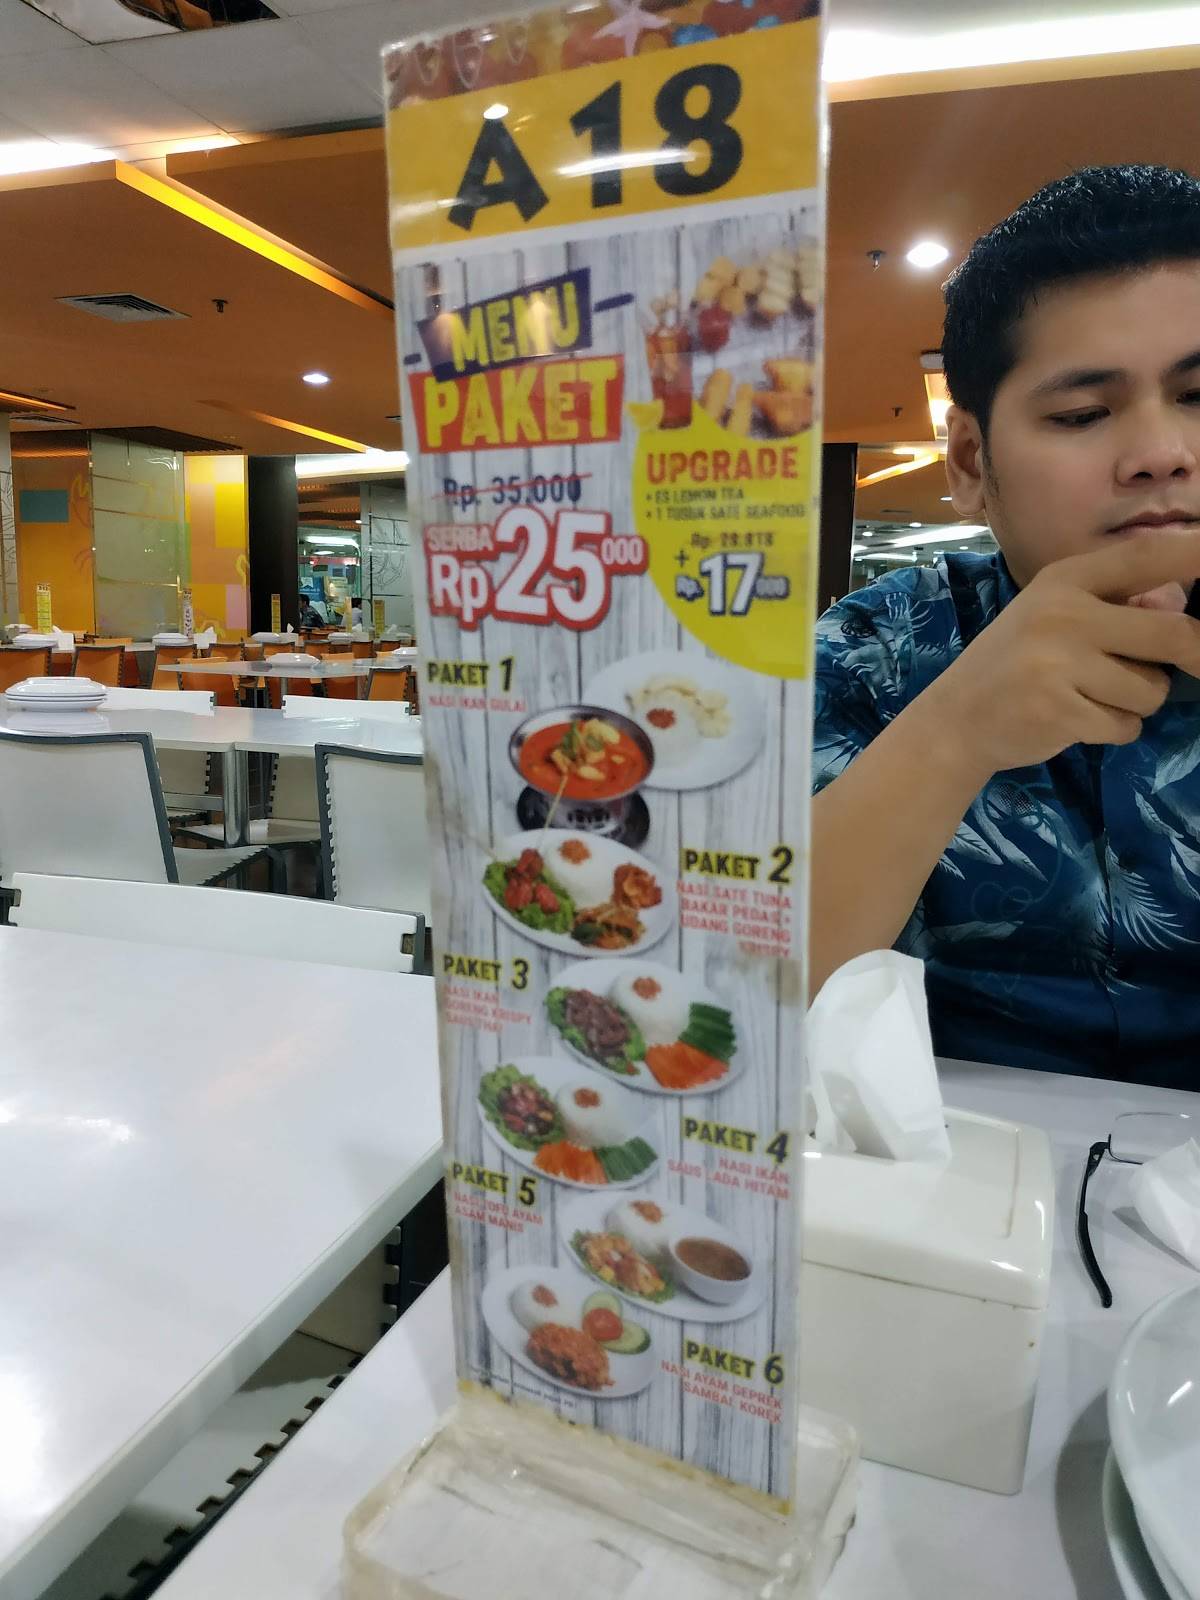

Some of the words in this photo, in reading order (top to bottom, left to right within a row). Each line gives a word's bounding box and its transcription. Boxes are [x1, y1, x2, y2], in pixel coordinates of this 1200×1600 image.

[452, 282, 580, 371] MENU
[424, 360, 619, 449] PAKET
[646, 447, 800, 485] UPGRADE
[427, 661, 488, 686] PAKET
[500, 658, 513, 691] 1
[685, 850, 760, 879] PAKET
[768, 846, 793, 882] 2
[443, 955, 502, 980] PAKET
[511, 959, 529, 990] 3
[684, 1118, 756, 1152] PAKET
[765, 1131, 790, 1164] 4
[453, 1162, 508, 1193] PAKET
[519, 1177, 536, 1206] 5
[686, 1340, 755, 1379] PAKET
[764, 1355, 784, 1385] 6
